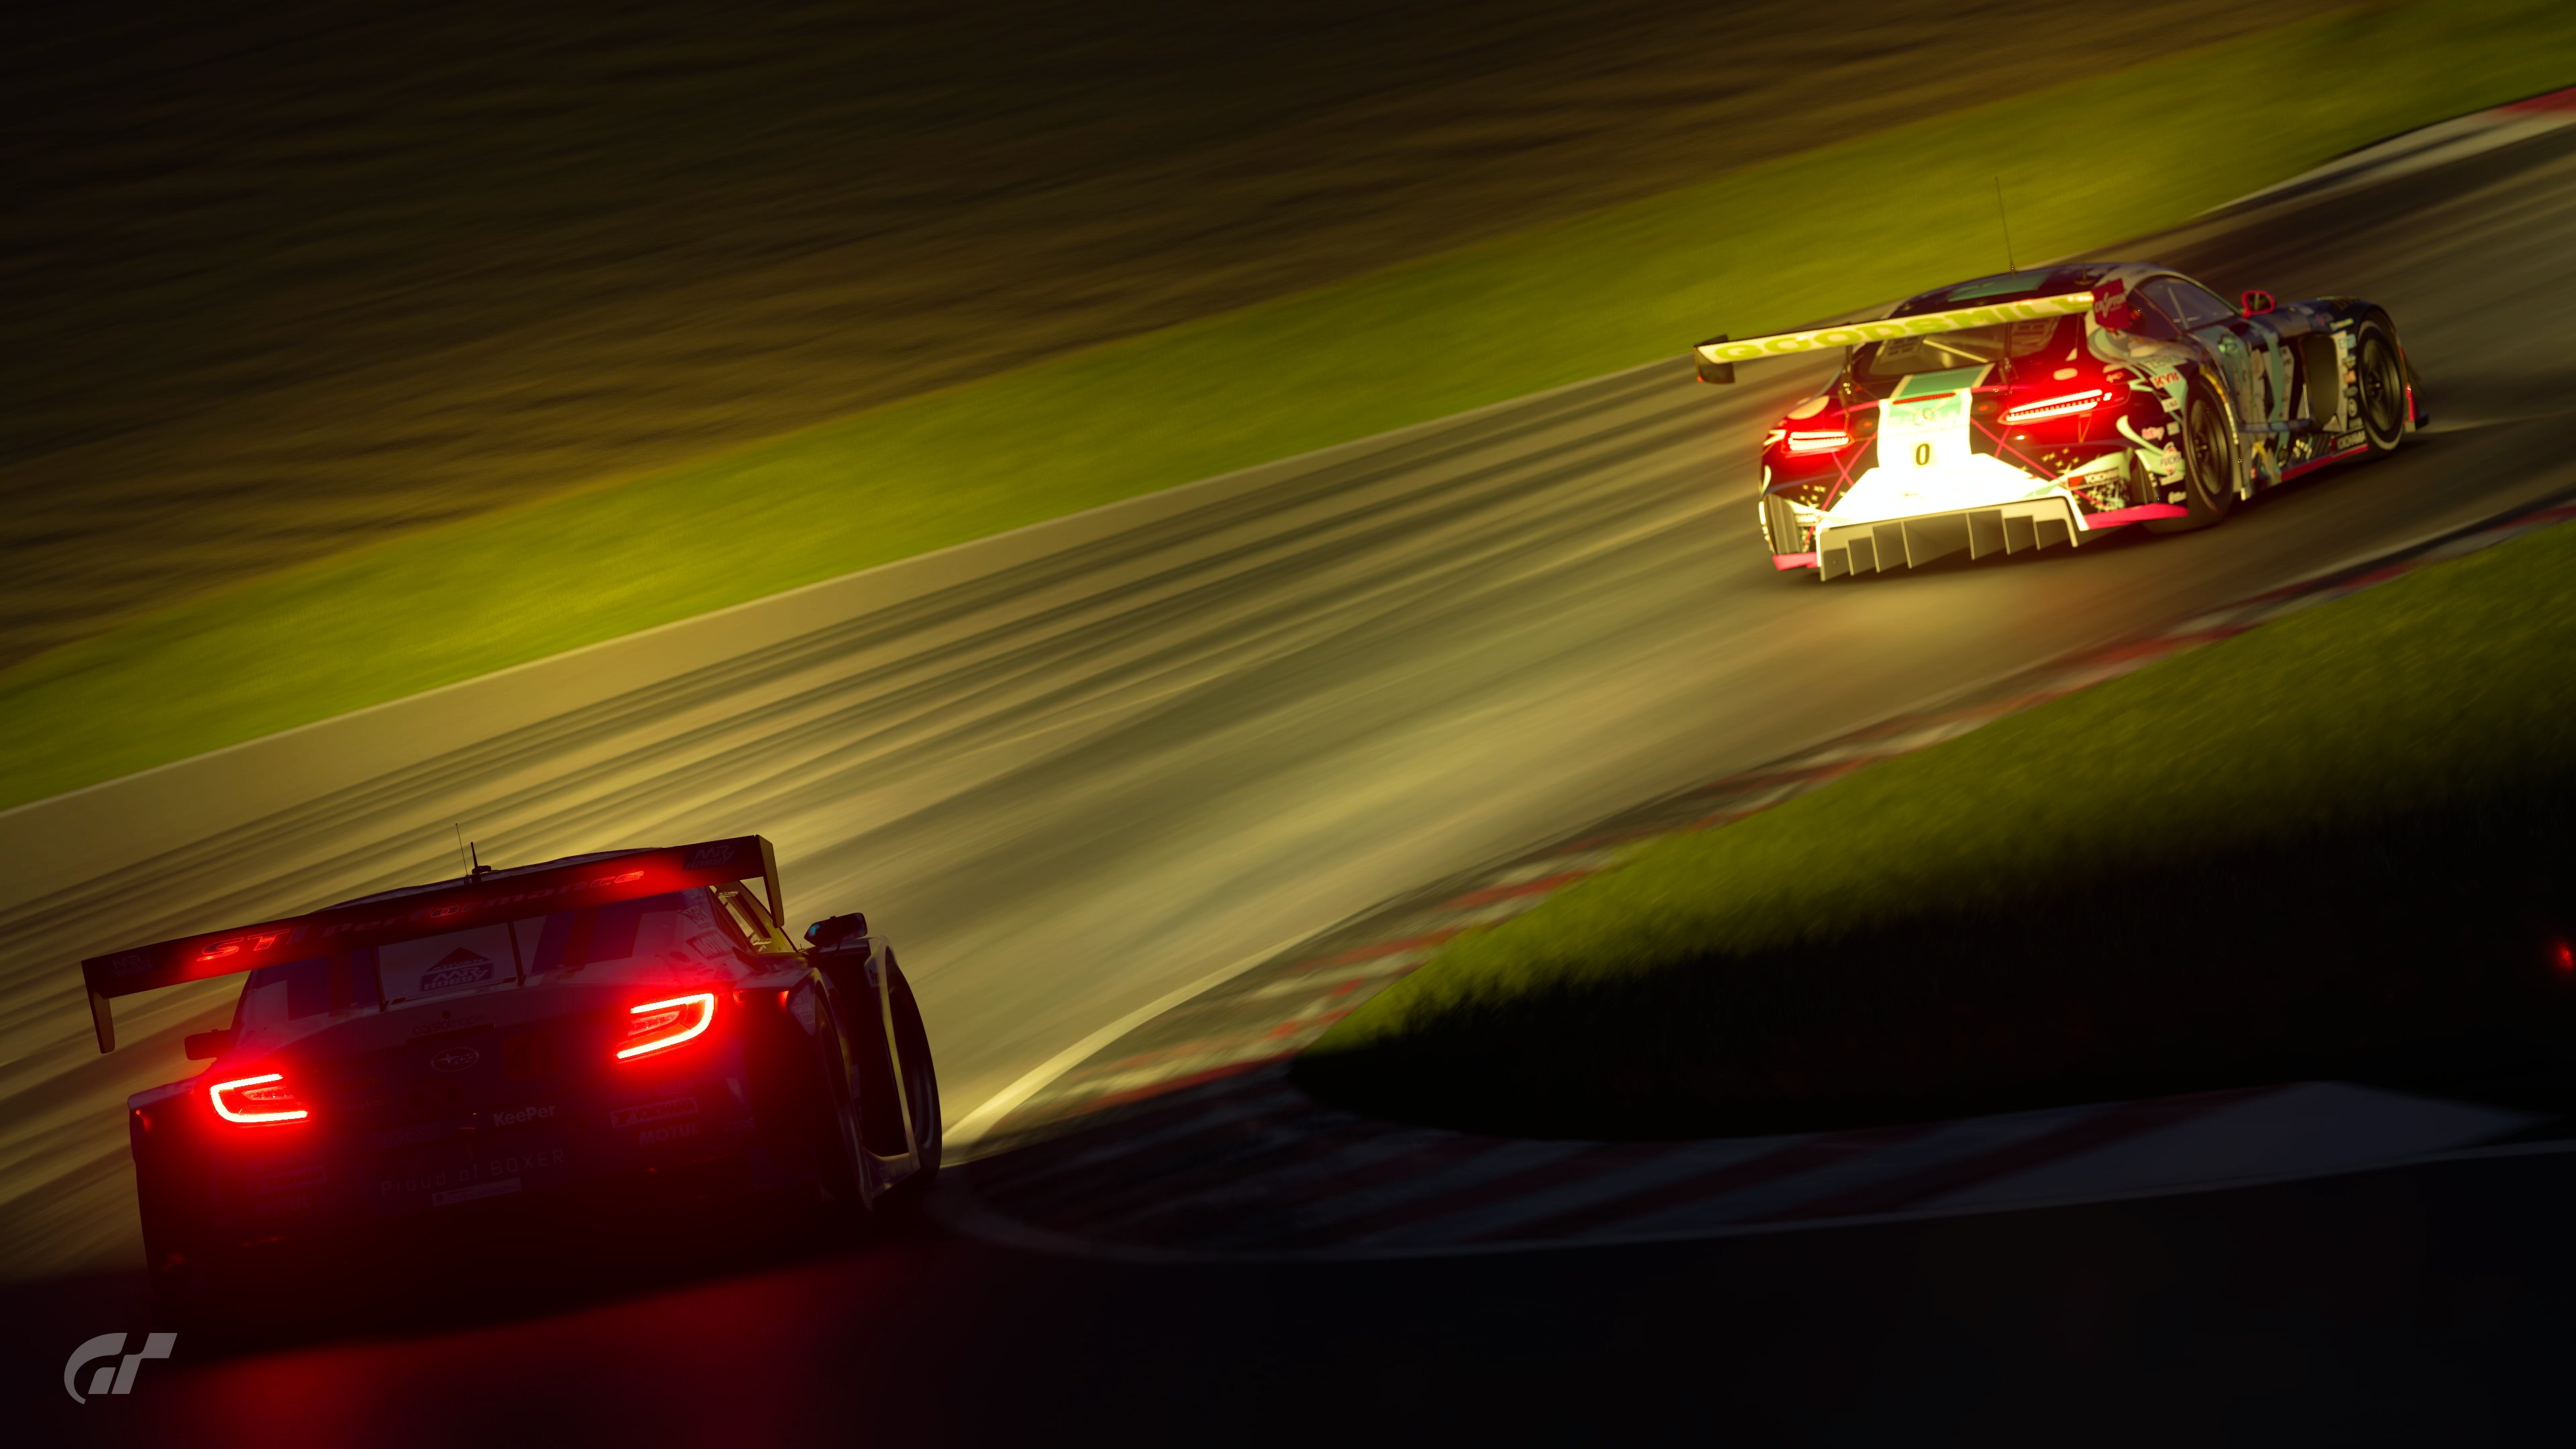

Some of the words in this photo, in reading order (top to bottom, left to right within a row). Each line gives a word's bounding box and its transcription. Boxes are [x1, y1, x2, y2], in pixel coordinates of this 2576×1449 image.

[492, 1106, 556, 1128] KeePer
[639, 1121, 698, 1146] MOTUL
[489, 1148, 564, 1176] BOXER
